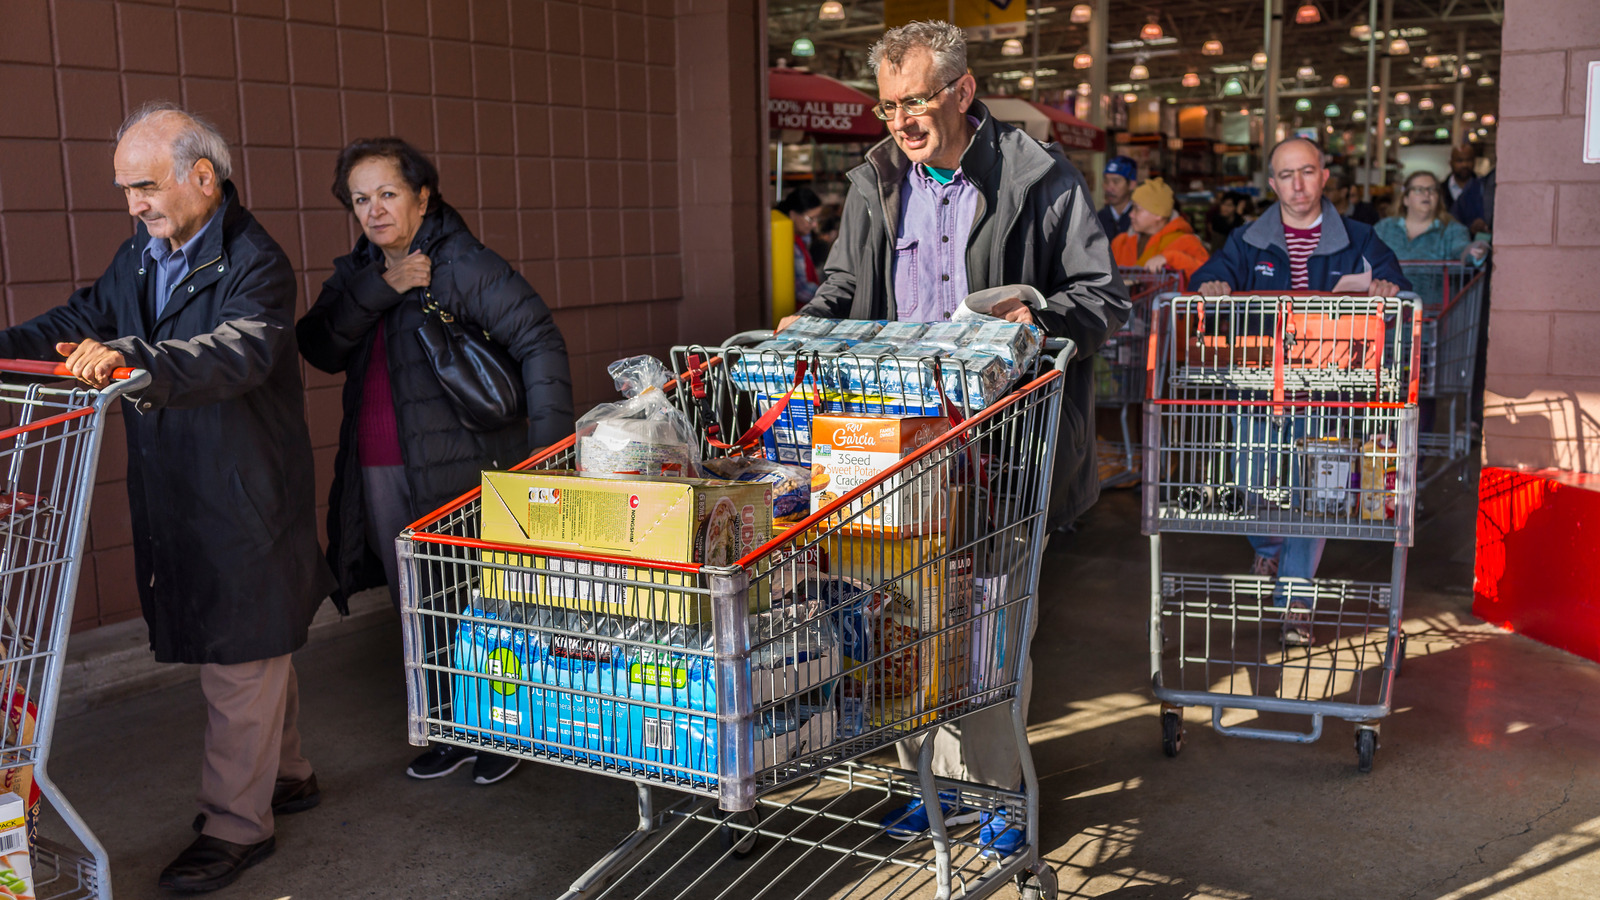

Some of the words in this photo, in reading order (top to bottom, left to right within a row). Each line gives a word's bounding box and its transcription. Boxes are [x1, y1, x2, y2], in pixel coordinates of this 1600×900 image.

[768, 100, 801, 113] 00%
[804, 102, 829, 115] ALL
[833, 103, 865, 117] BEEF
[778, 114, 808, 128] HOT
[811, 116, 853, 130] DOGS
[832, 428, 877, 447] Garcia
[837, 453, 871, 466] 3Seed
[826, 463, 852, 475] Sweet
[0, 819, 17, 829] ACK
